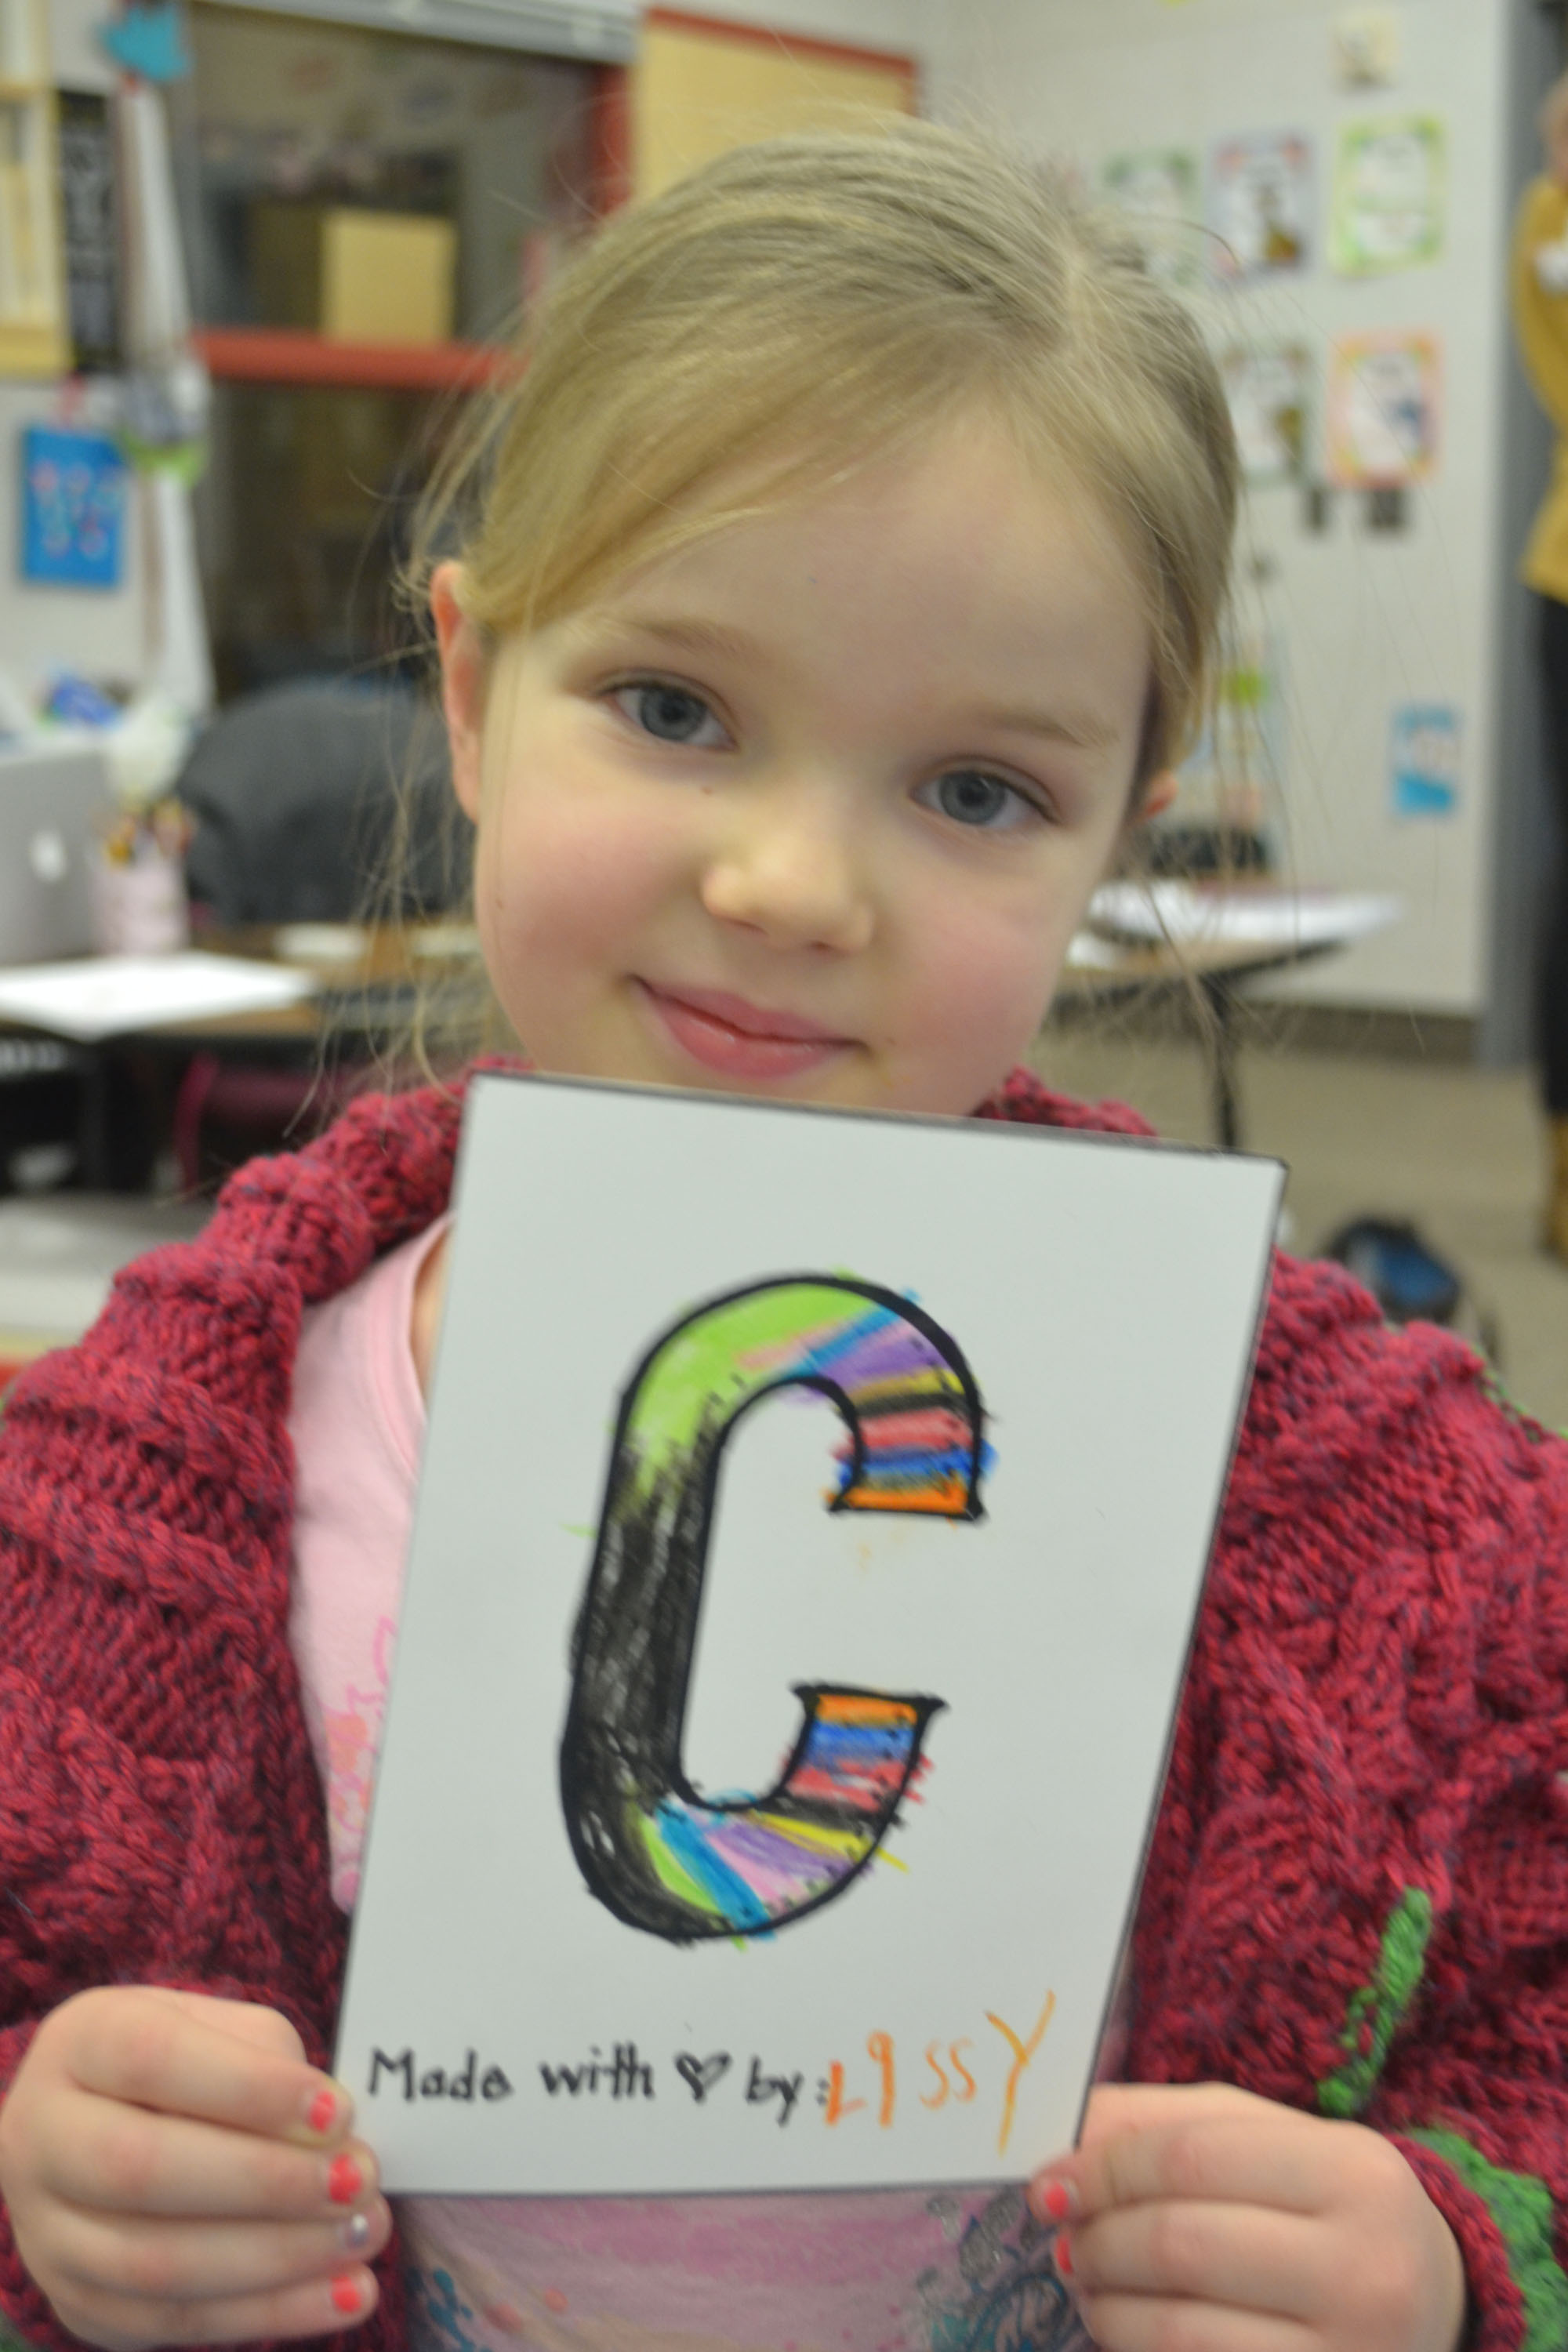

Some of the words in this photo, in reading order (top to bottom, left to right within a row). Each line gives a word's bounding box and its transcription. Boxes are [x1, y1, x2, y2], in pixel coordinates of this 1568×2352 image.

[559, 1272, 986, 1940] C
[368, 2047, 514, 2102] Made
[538, 2041, 654, 2100] with
